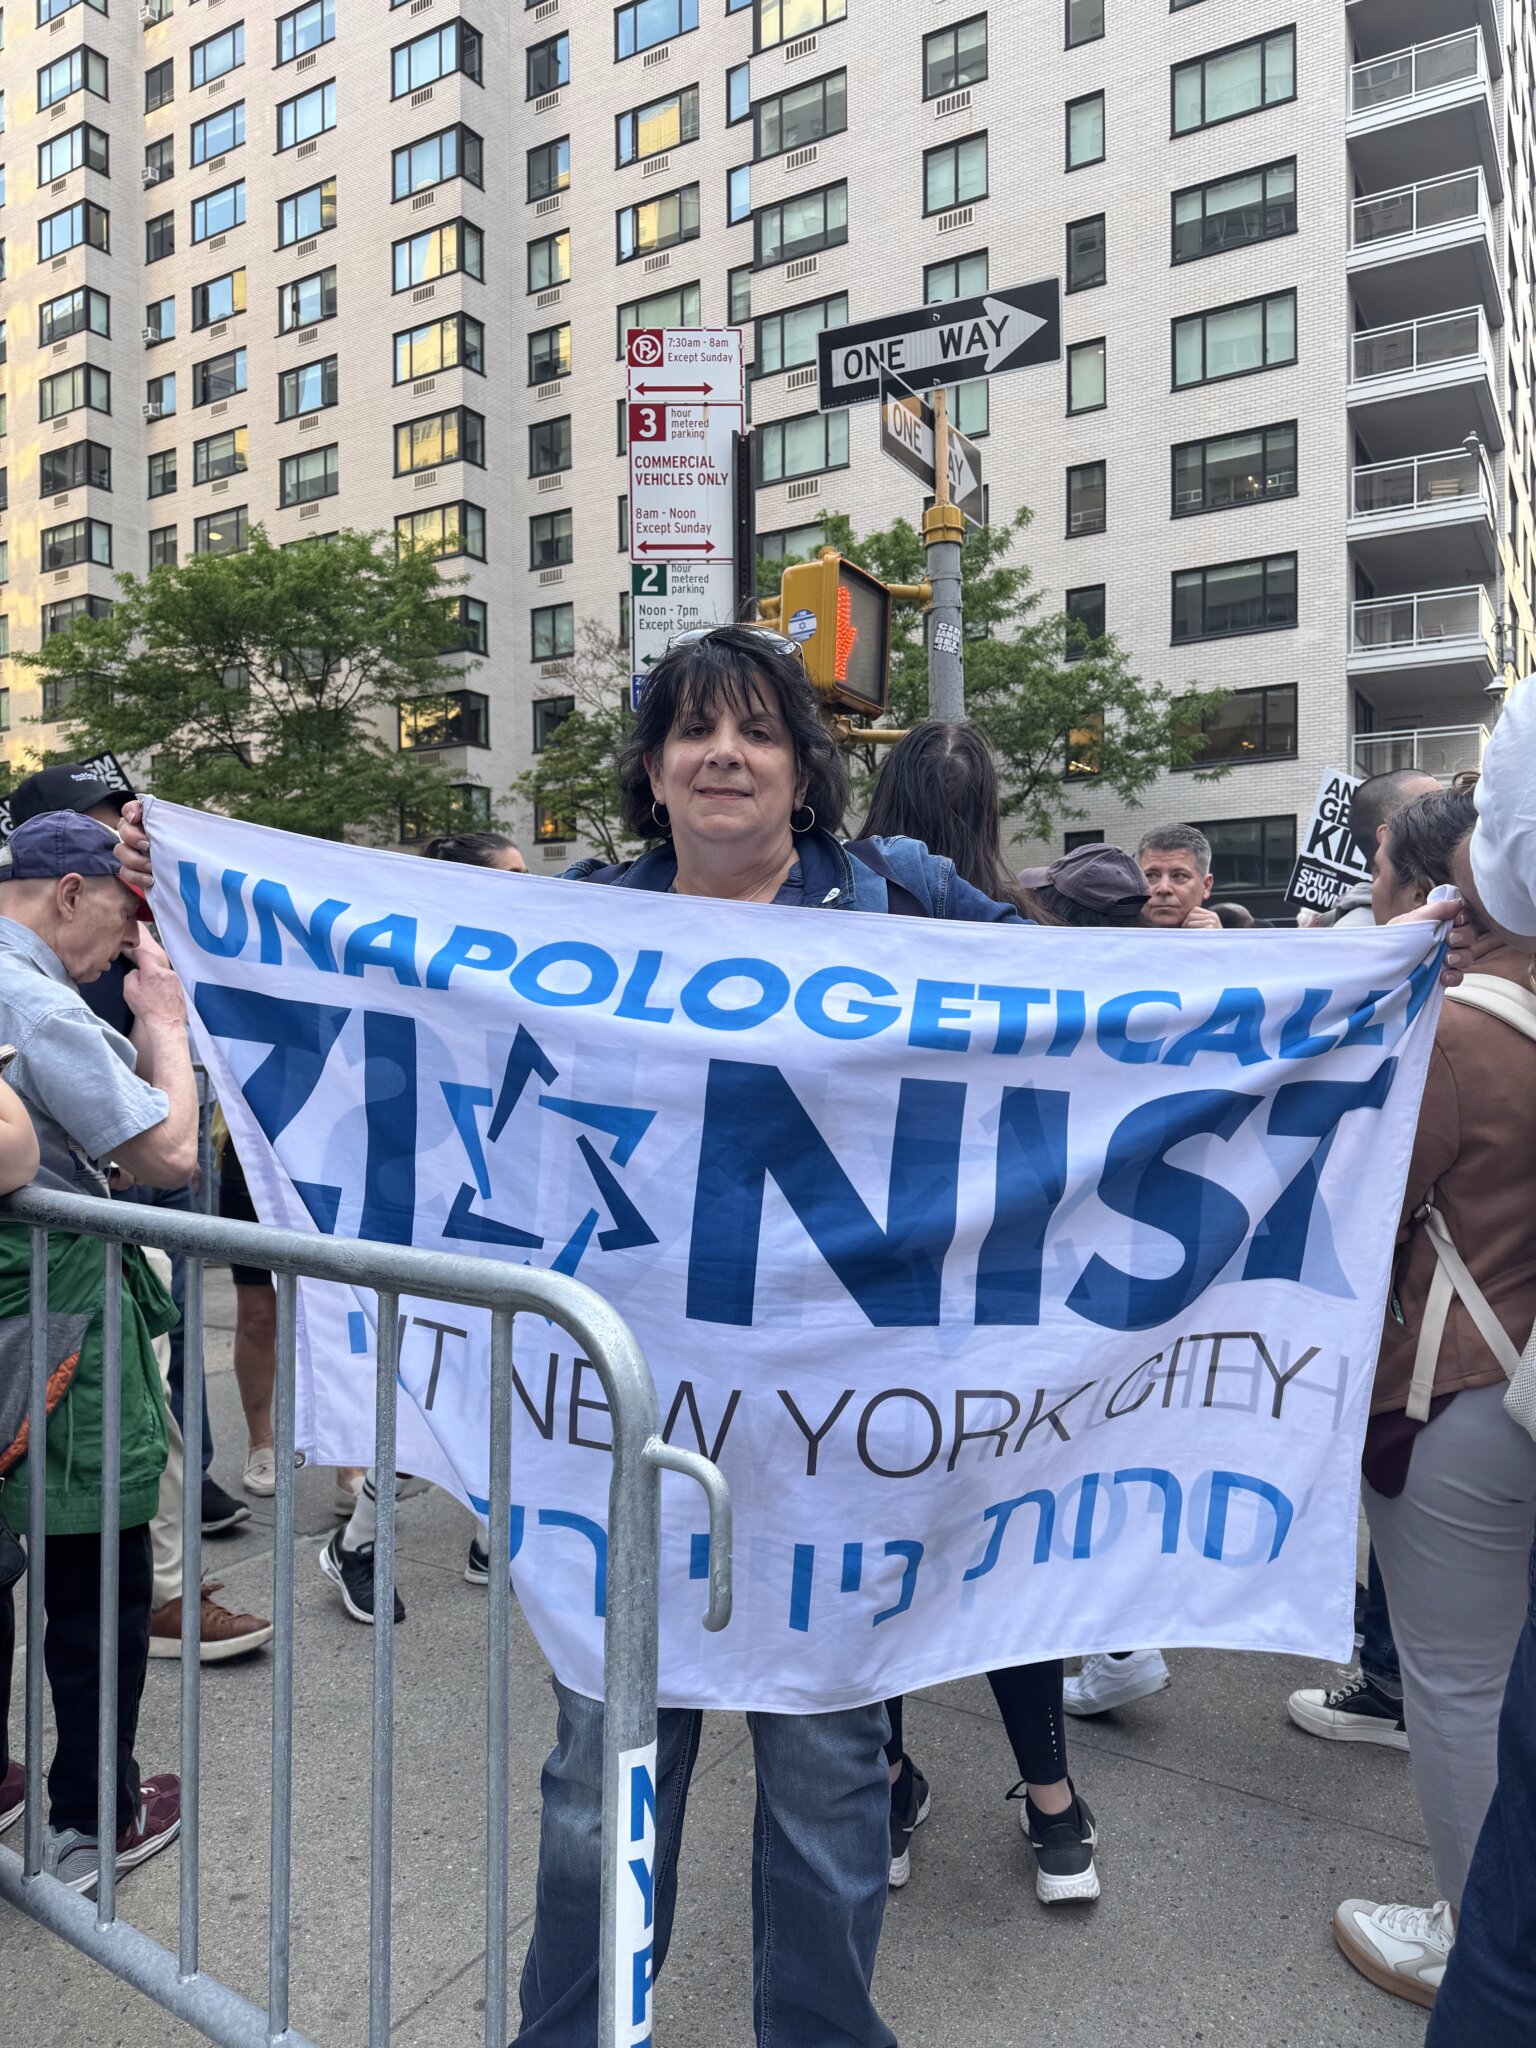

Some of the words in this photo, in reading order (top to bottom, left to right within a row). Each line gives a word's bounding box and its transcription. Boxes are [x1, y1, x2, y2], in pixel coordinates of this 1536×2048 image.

[668, 338, 700, 348] 7:30am
[709, 338, 729, 348] 8am
[844, 339, 905, 380] ONE
[939, 315, 1010, 359] WAY
[668, 353, 698, 363] Except
[700, 353, 733, 363] Sunday
[671, 408, 692, 418] hour
[639, 408, 658, 438] 3
[671, 418, 710, 428] metered
[671, 429, 705, 440] parking
[893, 403, 922, 455] ONE
[949, 449, 964, 486] AY
[634, 455, 716, 469] COMMERCIAL
[635, 473, 694, 486] VEHICLES
[697, 473, 729, 486] ONLY
[635, 508, 659, 519] 8am
[669, 508, 696, 519] Noon
[636, 522, 671, 536] Except
[674, 522, 712, 536] Sunday
[671, 564, 693, 573] hour
[641, 564, 659, 593] 2
[671, 574, 710, 584] metered
[671, 584, 705, 595] parking
[639, 604, 667, 616] Noon
[676, 605, 699, 618] 7pm
[639, 619, 674, 632] Except
[1297, 868, 1339, 893] SHUT
[777, 1380, 1097, 1479] YORK
[1105, 1331, 1322, 1419] CITY
[627, 1764, 656, 2048] NYP
